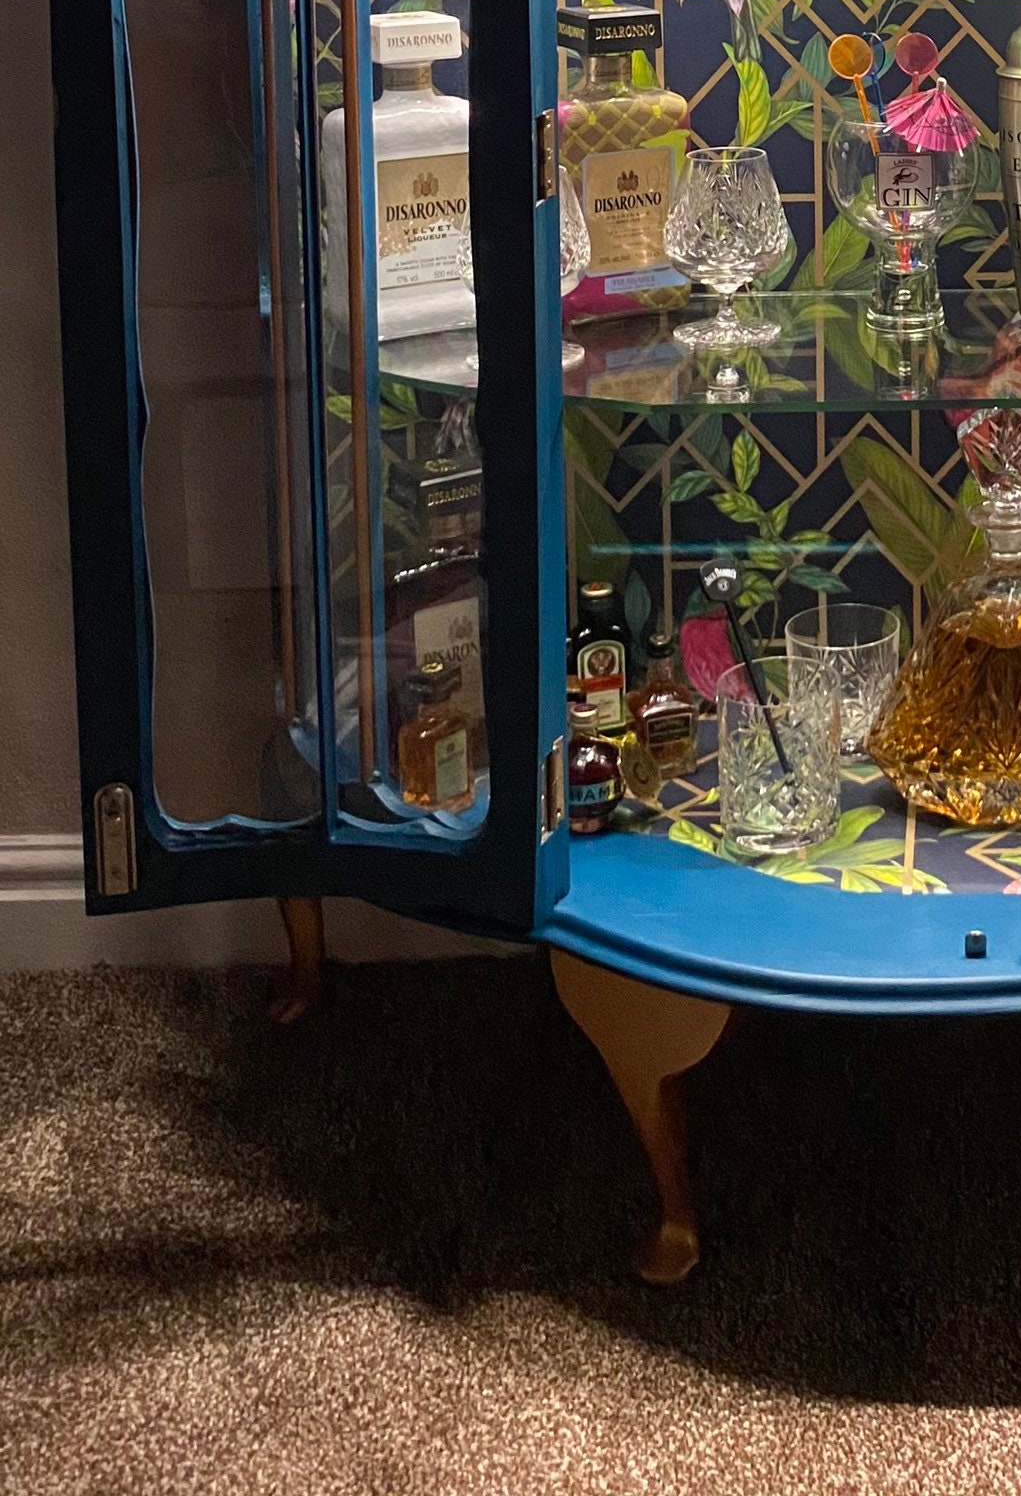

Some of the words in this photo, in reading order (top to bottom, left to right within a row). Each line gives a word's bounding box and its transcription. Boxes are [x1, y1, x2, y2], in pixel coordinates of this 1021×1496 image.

[387, 32, 453, 48] DISARONNO
[594, 23, 656, 41] DISARONNO
[595, 191, 662, 214] DISARONNO
[881, 187, 932, 207] GIN
[385, 198, 467, 223] DISARONNO
[404, 224, 452, 235] VELVET
[408, 233, 447, 243] LIQUEUR
[427, 483, 481, 507] DISARONN
